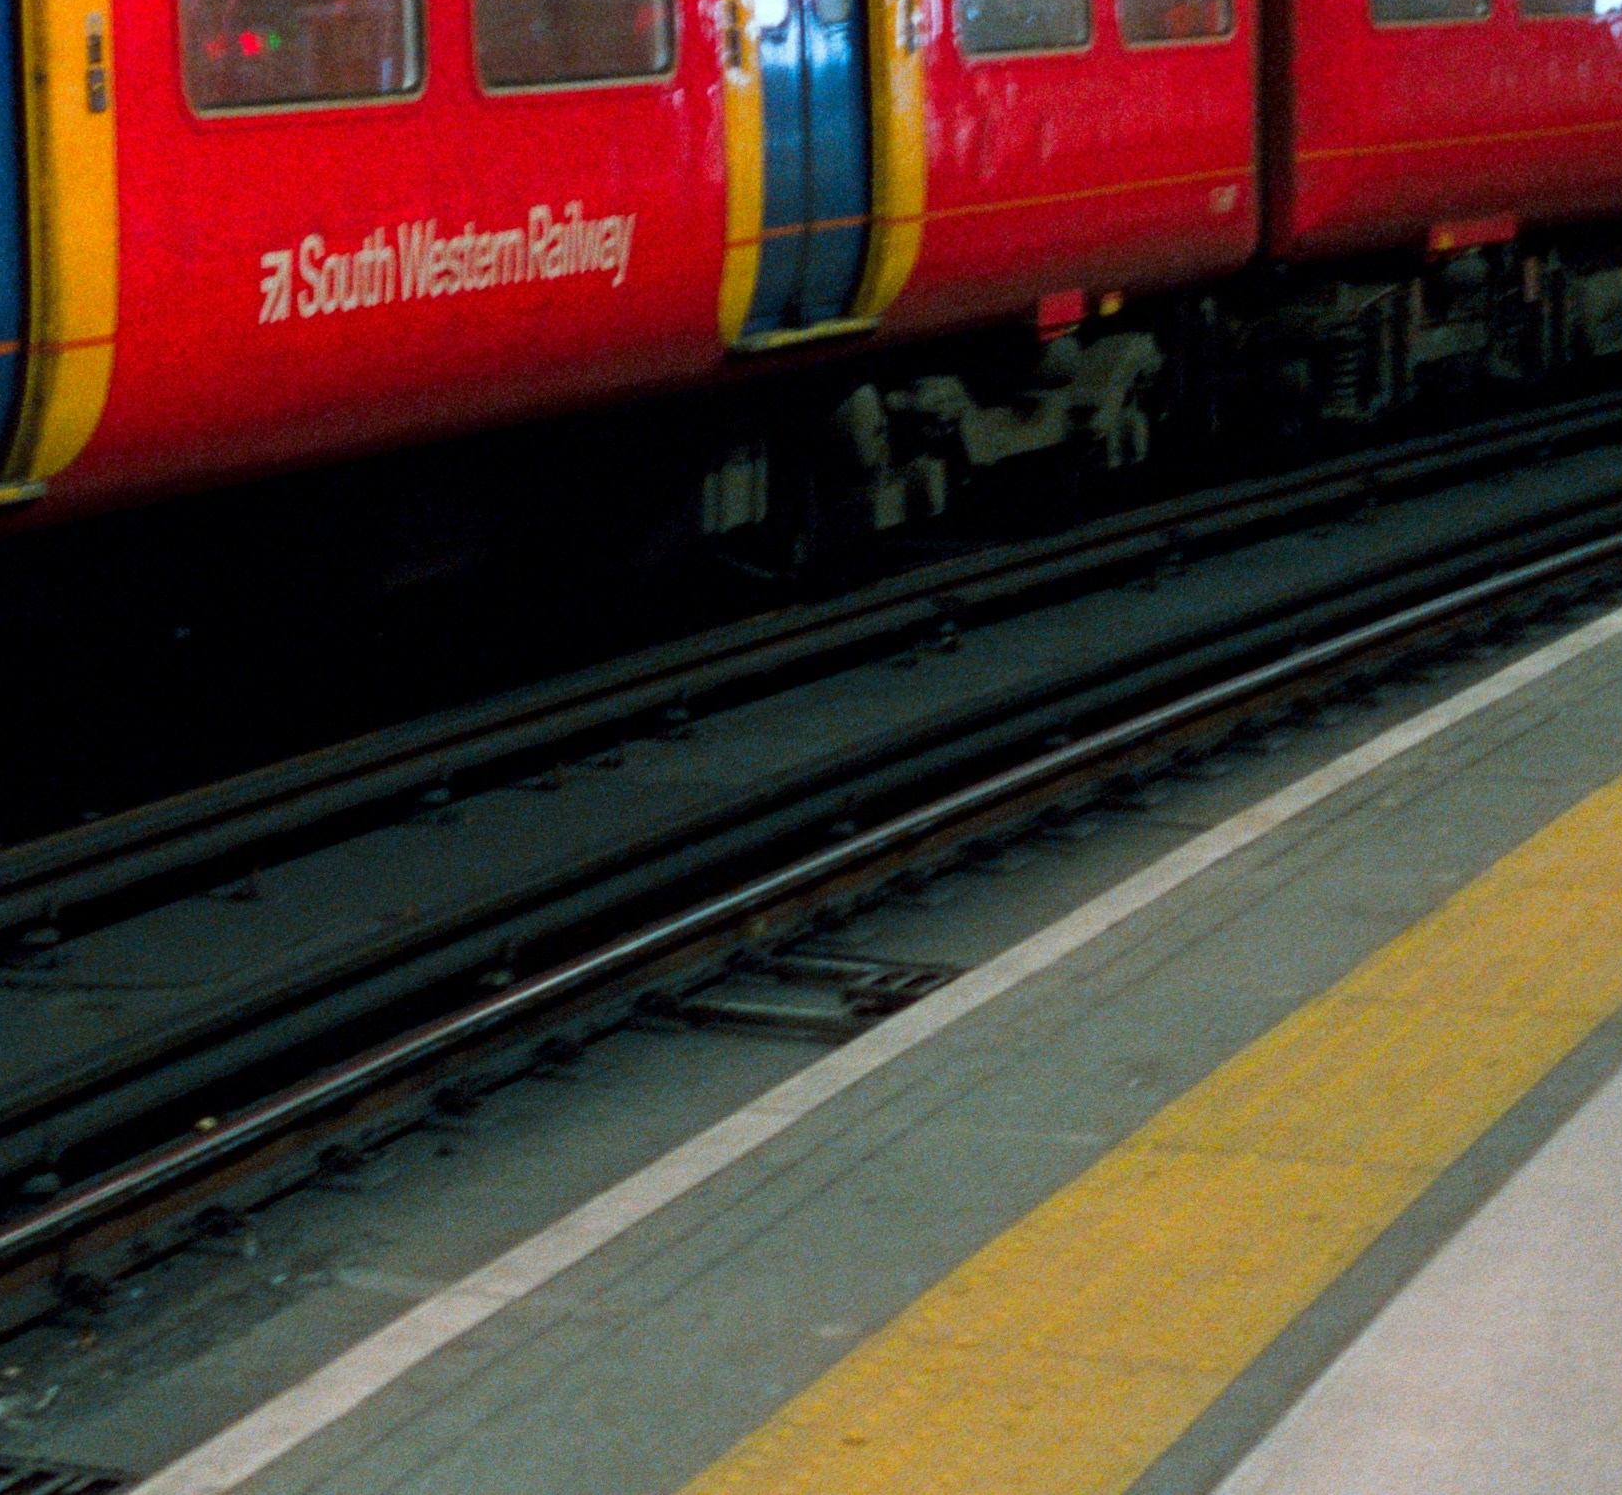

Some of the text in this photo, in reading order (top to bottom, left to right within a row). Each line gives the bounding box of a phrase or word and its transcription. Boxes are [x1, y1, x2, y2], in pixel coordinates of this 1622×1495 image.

[298, 199, 636, 319] South Western Railway
